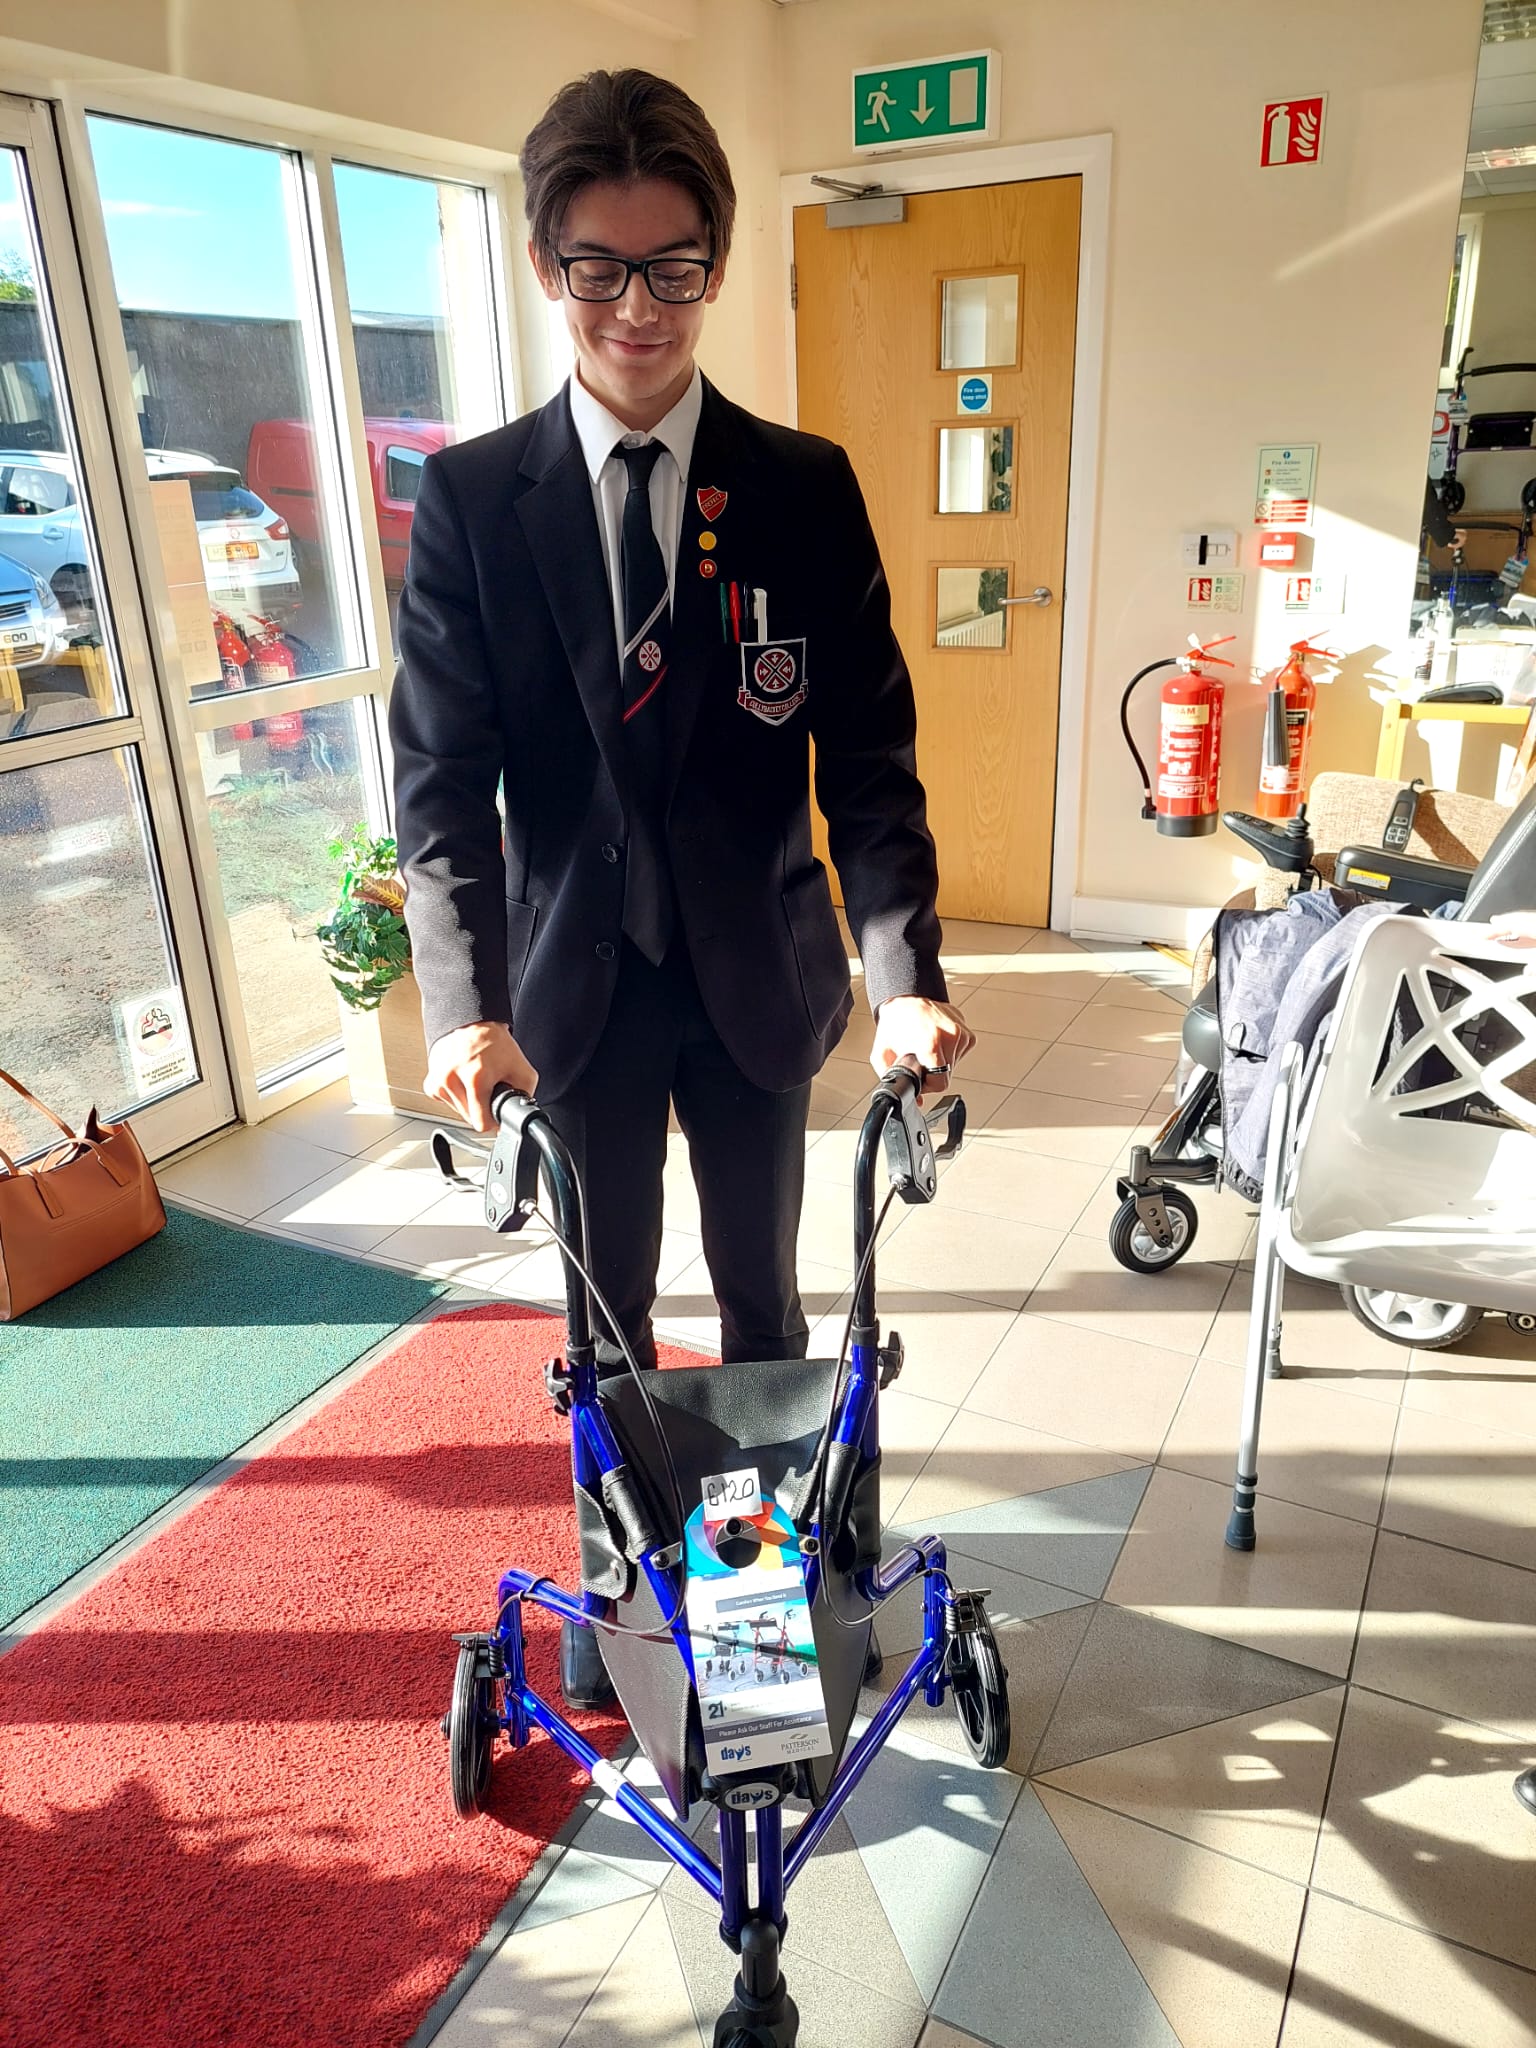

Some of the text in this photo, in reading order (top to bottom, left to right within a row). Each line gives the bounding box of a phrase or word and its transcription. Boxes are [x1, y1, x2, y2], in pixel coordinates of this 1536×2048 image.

[706, 1477, 754, 1506] £120
[719, 1729, 737, 1737] Please
[738, 1726, 748, 1734] Ask
[760, 1721, 773, 1730] Staff
[784, 1716, 813, 1726] Assistance
[721, 1745, 752, 1761] days
[781, 1739, 819, 1751] PATTERSON
[786, 1746, 816, 1754] MEDICAL
[731, 1788, 773, 1804] days
